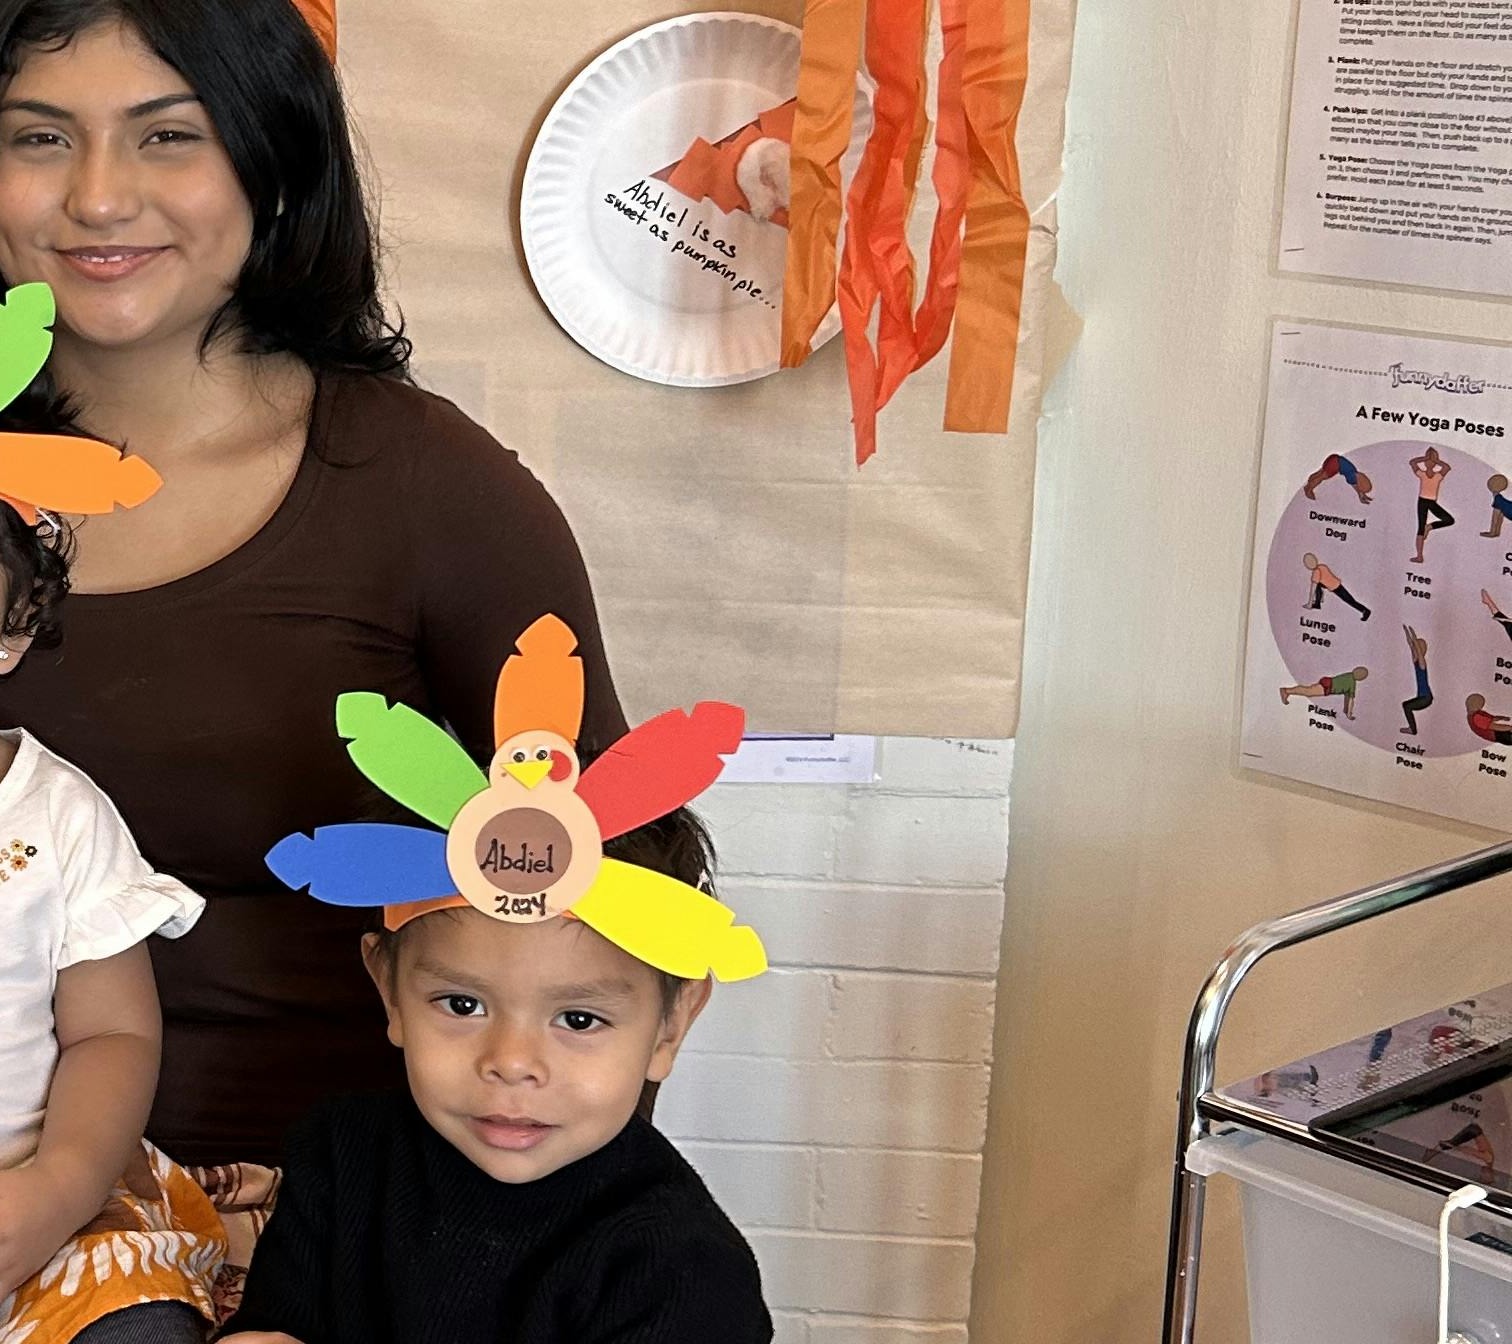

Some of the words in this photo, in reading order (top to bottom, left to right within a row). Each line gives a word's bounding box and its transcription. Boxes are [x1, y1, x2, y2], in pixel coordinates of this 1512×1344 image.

[623, 179, 688, 227] Abdiel
[692, 220, 710, 242] is
[713, 239, 737, 258] as
[604, 192, 648, 225] sweet
[649, 223, 669, 242] as
[671, 240, 736, 282] pumpkin
[1355, 405, 1368, 419] A
[1372, 407, 1404, 423] Few
[1408, 412, 1450, 431] Yoga
[1454, 418, 1504, 437] Poses
[1309, 511, 1366, 528] Downward
[1325, 528, 1347, 541] Dog
[1406, 572, 1432, 585] Tree
[1404, 586, 1431, 600] Pose
[1299, 616, 1336, 632] Lunge
[1302, 633, 1331, 647] Pose
[1308, 704, 1337, 719] Plank
[1309, 718, 1334, 732] Pose
[1396, 742, 1426, 756] Chair
[1481, 749, 1507, 763] Bow
[1396, 756, 1423, 770] Pose
[1478, 763, 1507, 778] Pose
[479, 838, 554, 874] Abdiel
